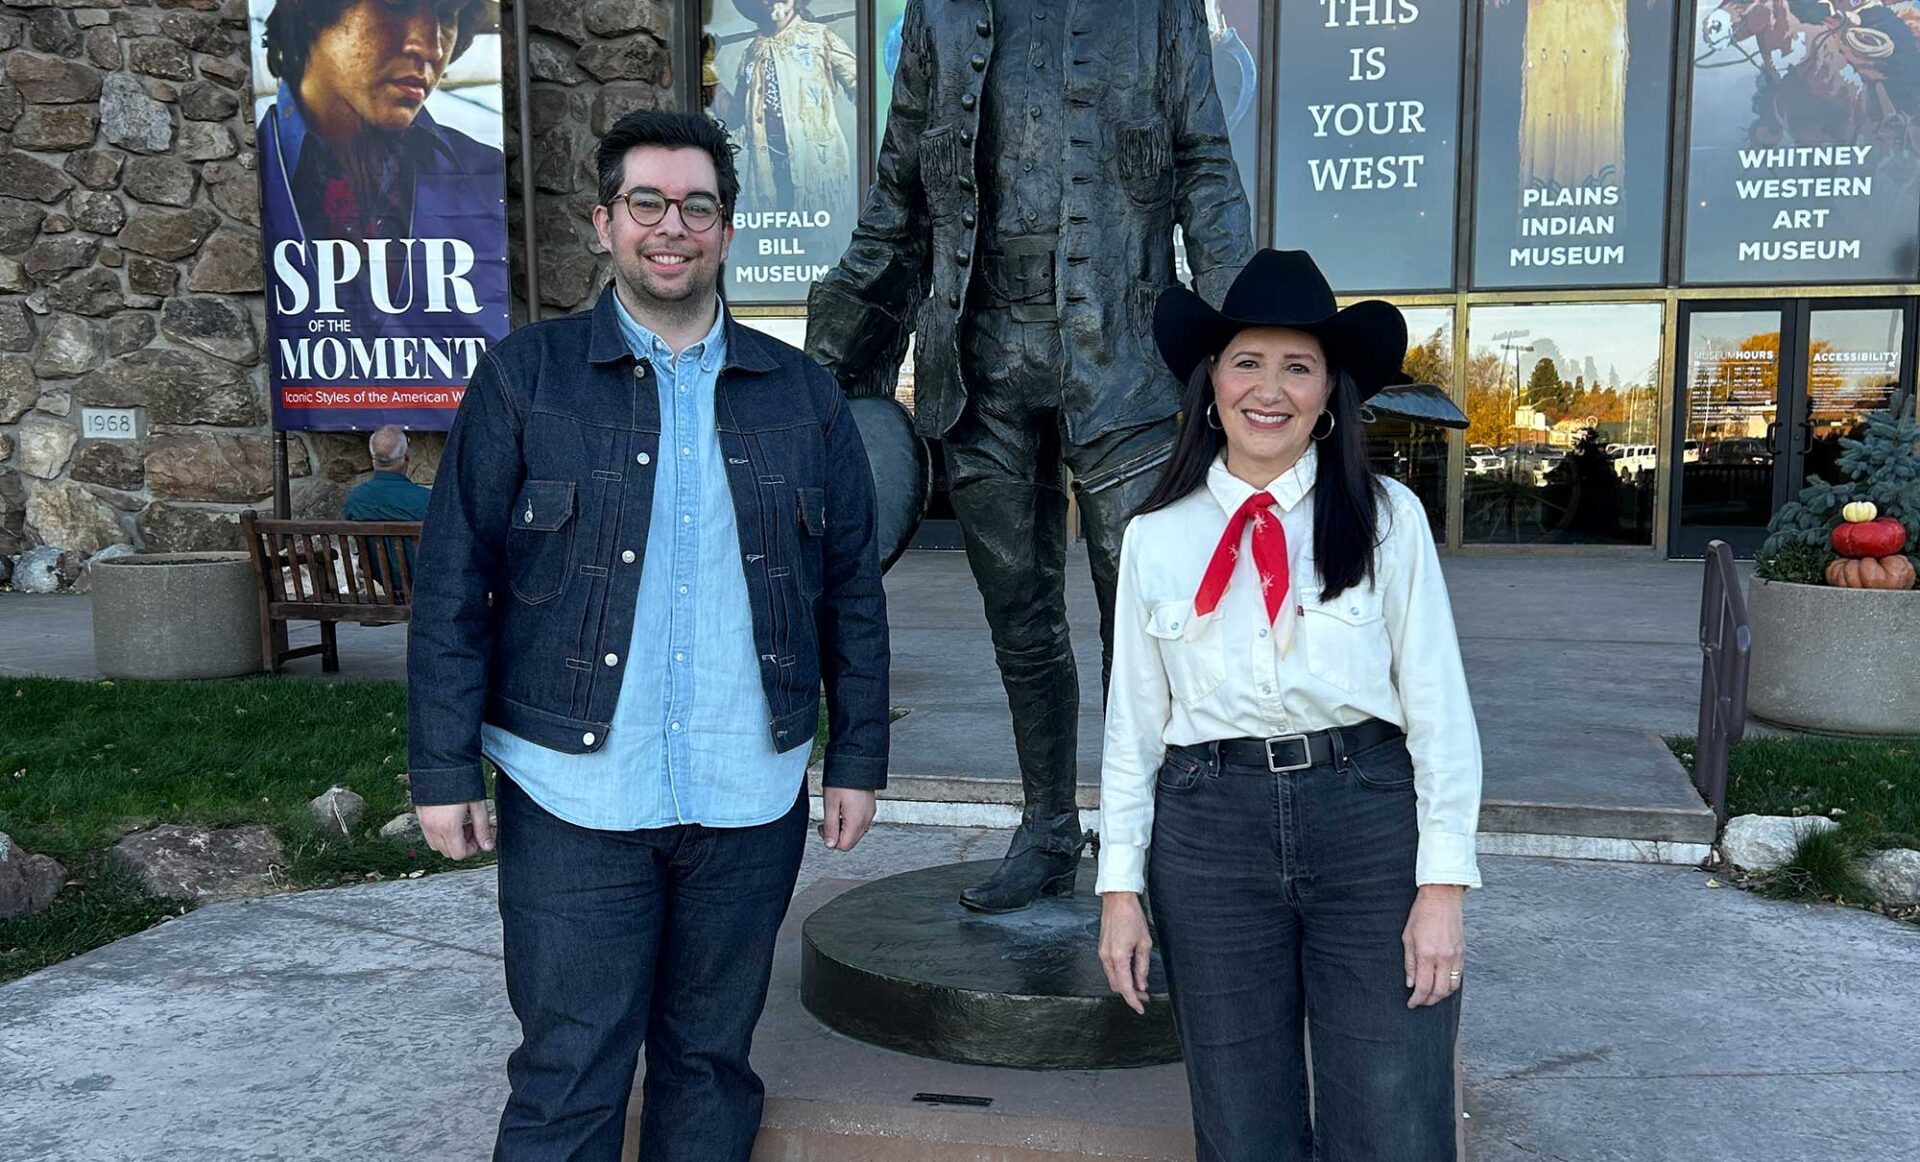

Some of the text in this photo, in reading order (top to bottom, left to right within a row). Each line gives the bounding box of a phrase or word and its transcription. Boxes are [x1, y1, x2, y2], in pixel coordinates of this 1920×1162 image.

[1319, 0, 1419, 27] THIS
[1349, 47, 1386, 81] IS
[1308, 100, 1426, 137] YOUR
[1738, 145, 1873, 168] WHITNEY
[1307, 155, 1425, 191] WEST
[1523, 185, 1619, 207] PLAINS
[1735, 176, 1872, 199] WESTERN
[732, 210, 831, 229] BUFFALO
[1522, 215, 1615, 236] INDIAN
[1772, 209, 1830, 229] ART
[758, 238, 805, 255] BILL
[1510, 245, 1625, 267] MUSEUM
[1738, 239, 1861, 261] MUSEUM
[273, 238, 484, 315] SPUR
[735, 264, 830, 283] MUSEUM
[309, 320, 351, 333] OF THE
[279, 337, 486, 380] MOMENT
[1813, 351, 1899, 362] ACCESSIBILITY
[285, 391, 313, 403] Iconic
[315, 391, 350, 405] Styles
[353, 391, 365, 403] of
[368, 391, 388, 403] the
[391, 391, 449, 403] American
[88, 415, 131, 432] 1968
